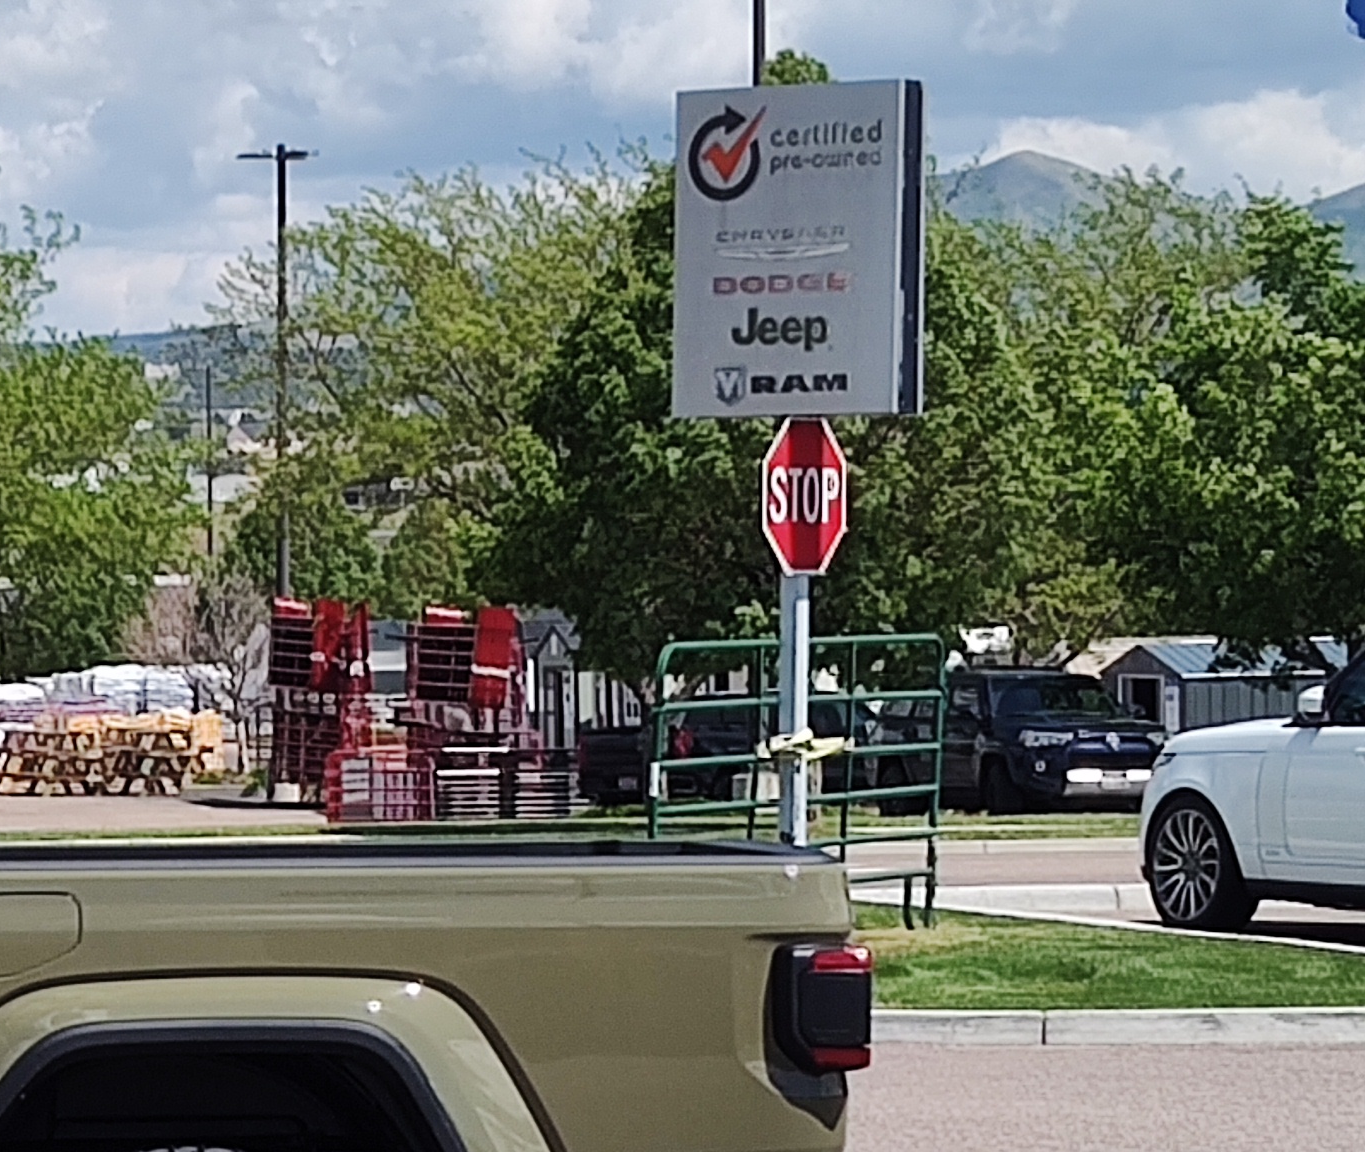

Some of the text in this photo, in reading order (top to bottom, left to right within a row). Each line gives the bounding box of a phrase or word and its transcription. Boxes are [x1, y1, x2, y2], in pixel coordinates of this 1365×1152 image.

[770, 119, 882, 147] certified
[770, 147, 882, 175] pre-owned
[713, 272, 847, 295] DODGE
[731, 307, 828, 351] Jeep
[750, 373, 848, 394] RAM
[769, 465, 840, 524] STOP
